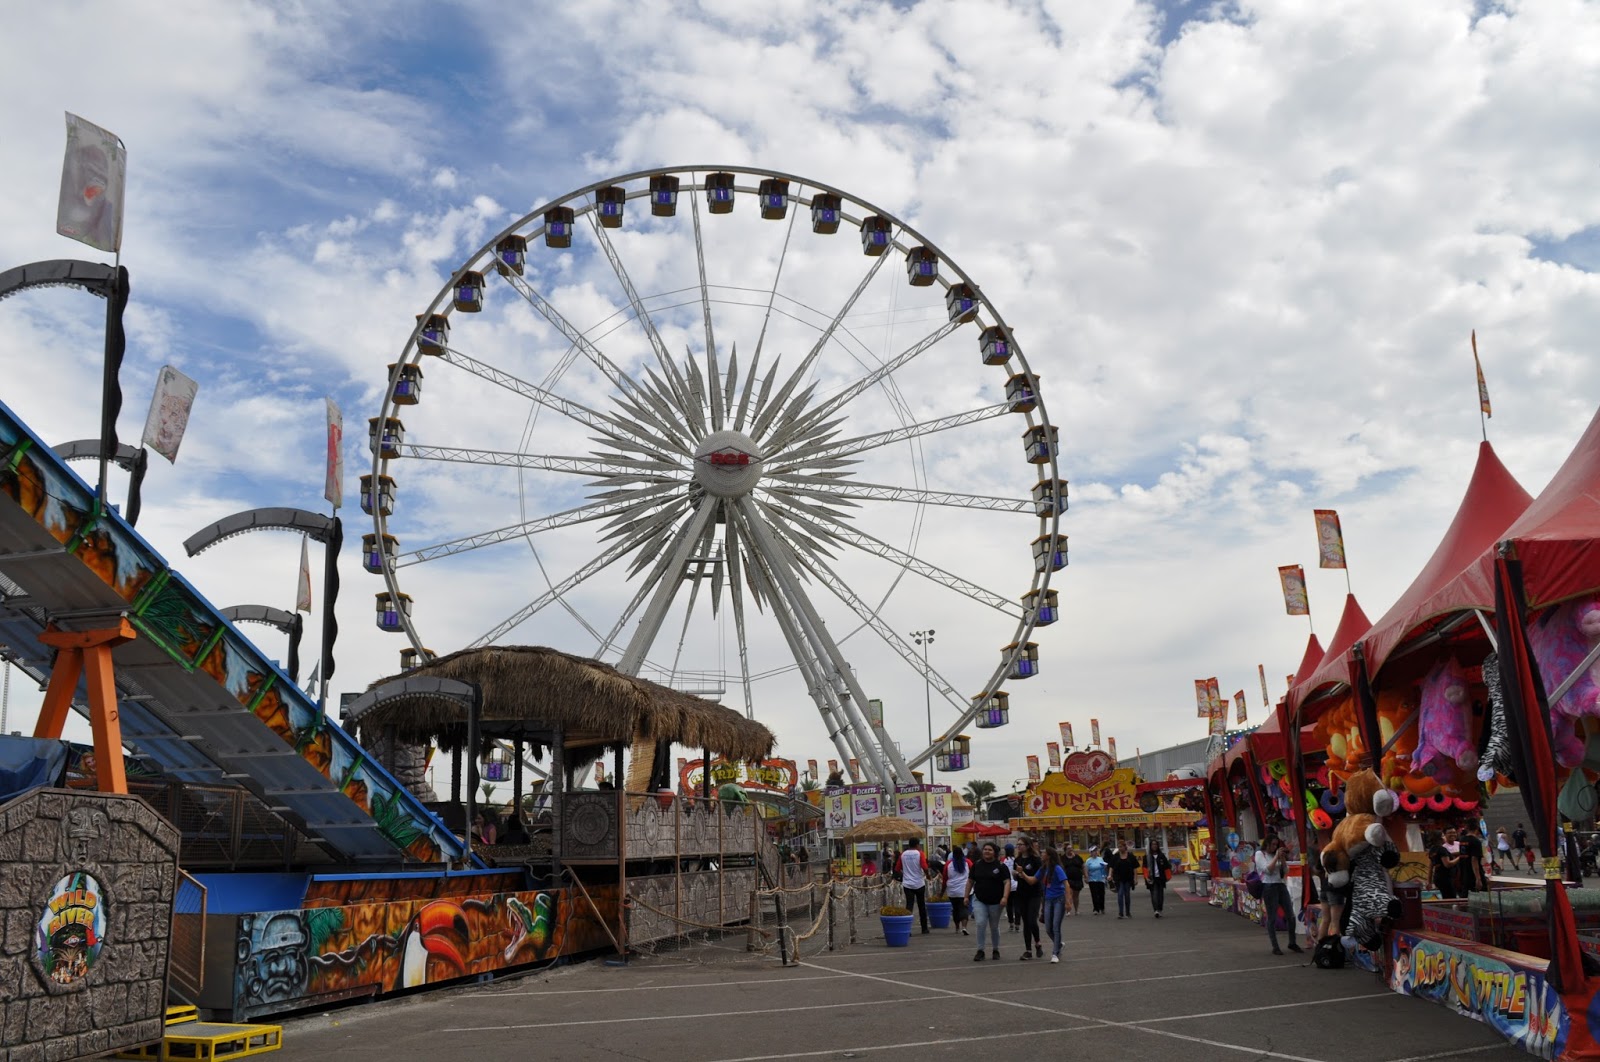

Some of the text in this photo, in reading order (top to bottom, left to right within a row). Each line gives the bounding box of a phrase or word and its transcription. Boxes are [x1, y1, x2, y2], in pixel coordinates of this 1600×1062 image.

[829, 788, 846, 797] TICKETS
[856, 787, 877, 796] TICKETS
[900, 785, 921, 795] TICKETS
[931, 787, 947, 795] TICKETS
[1041, 782, 1125, 811] FUNNEL
[1071, 795, 1140, 811] CAKES
[48, 889, 97, 915] WILD
[49, 908, 95, 936] RIVER
[1413, 948, 1447, 988] RING
